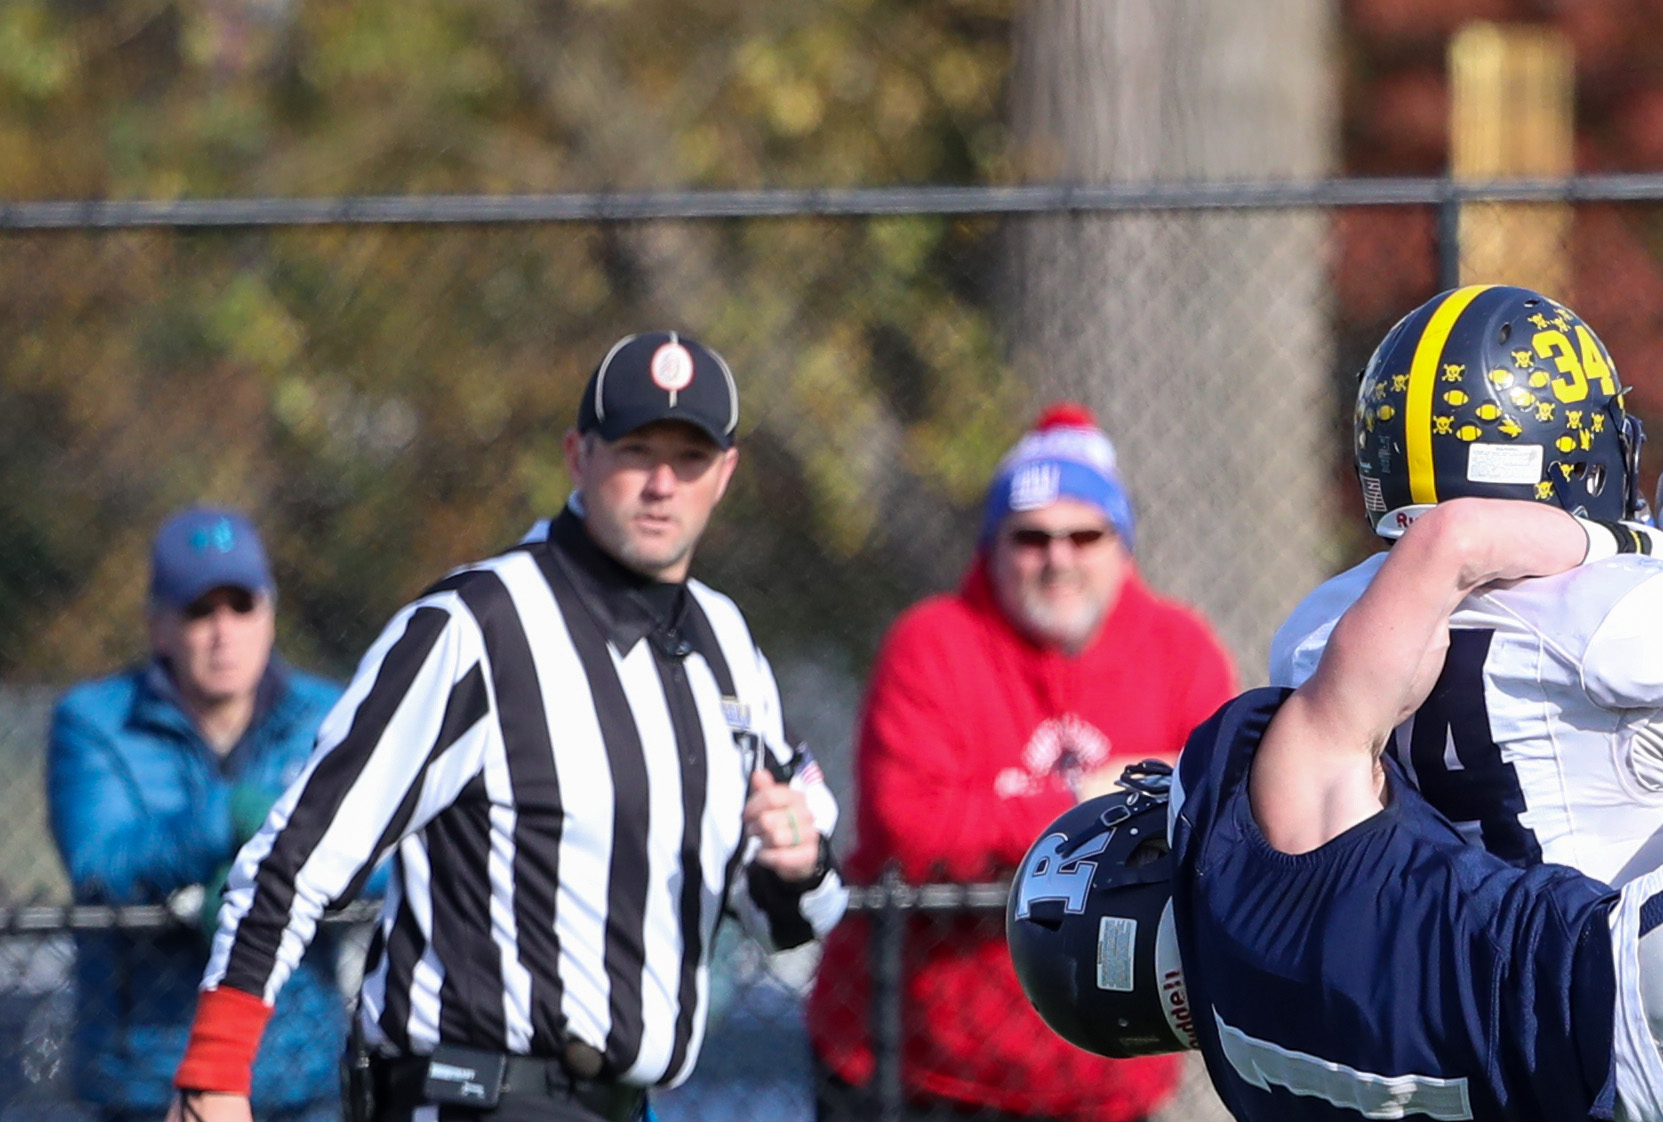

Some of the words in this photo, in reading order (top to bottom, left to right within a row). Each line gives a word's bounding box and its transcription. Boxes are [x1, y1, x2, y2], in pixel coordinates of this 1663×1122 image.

[1532, 325, 1615, 404] 34
[1015, 827, 1117, 921] R
[1212, 1003, 1473, 1119] 1
